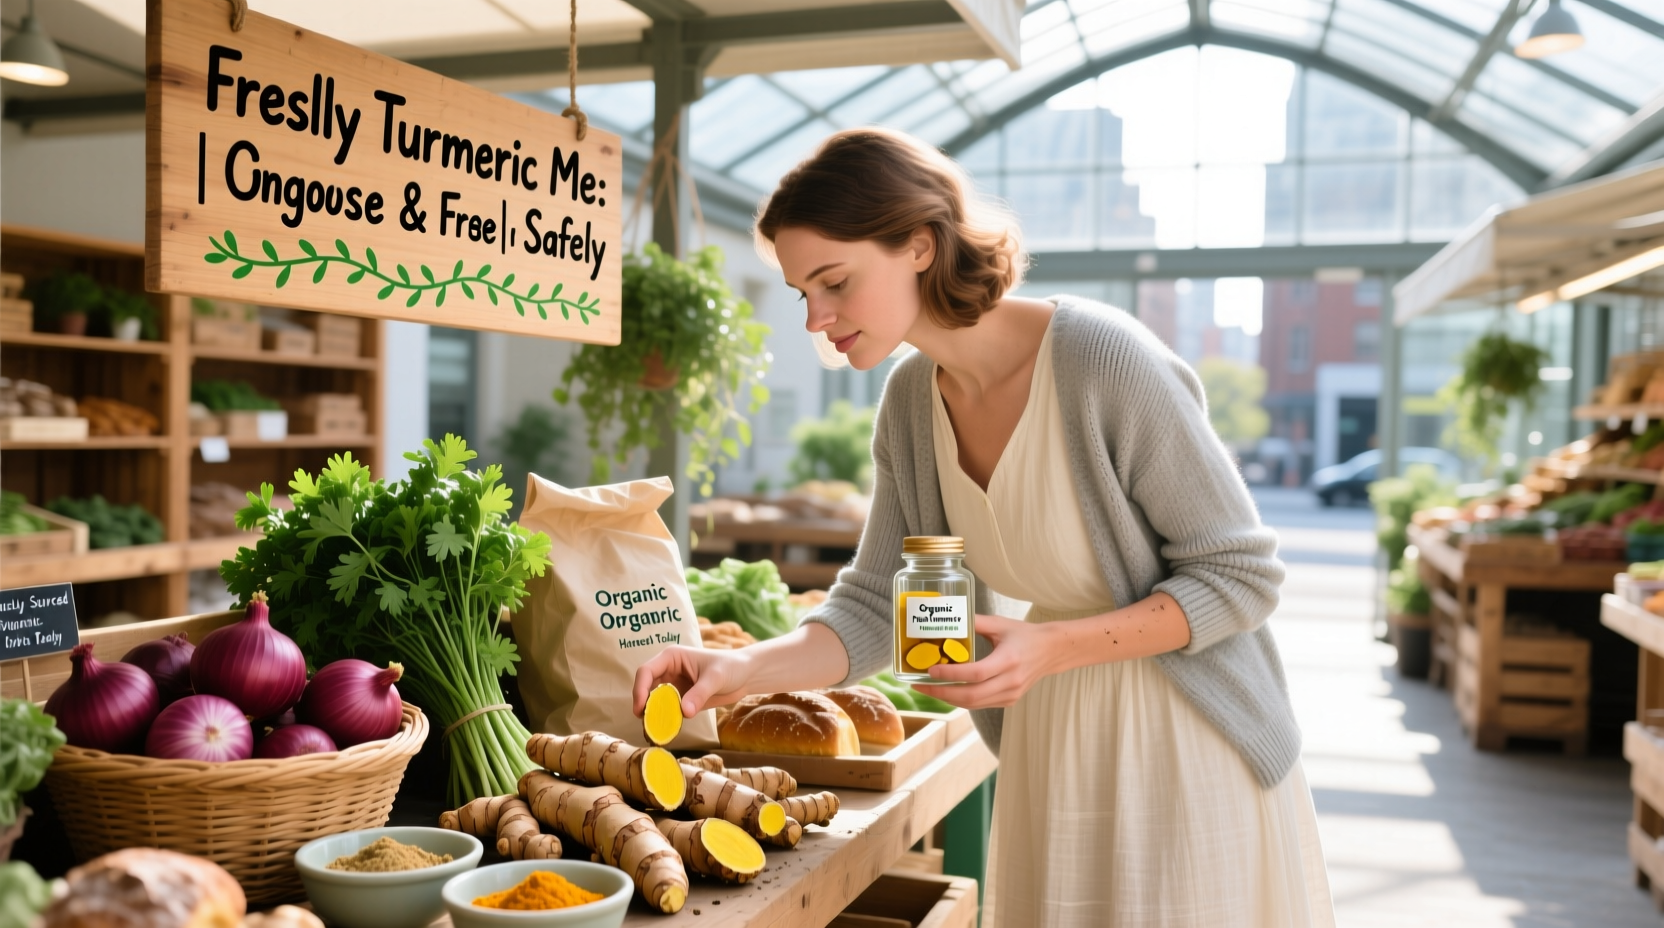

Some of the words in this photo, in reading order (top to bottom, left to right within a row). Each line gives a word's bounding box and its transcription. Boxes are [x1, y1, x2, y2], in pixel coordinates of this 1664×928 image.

[207, 44, 361, 165] Freslly
[373, 89, 539, 191] Turmeric
[549, 146, 607, 208] Me:
[400, 181, 427, 234] &
[523, 208, 606, 281] Safely
[595, 583, 668, 610] Organic
